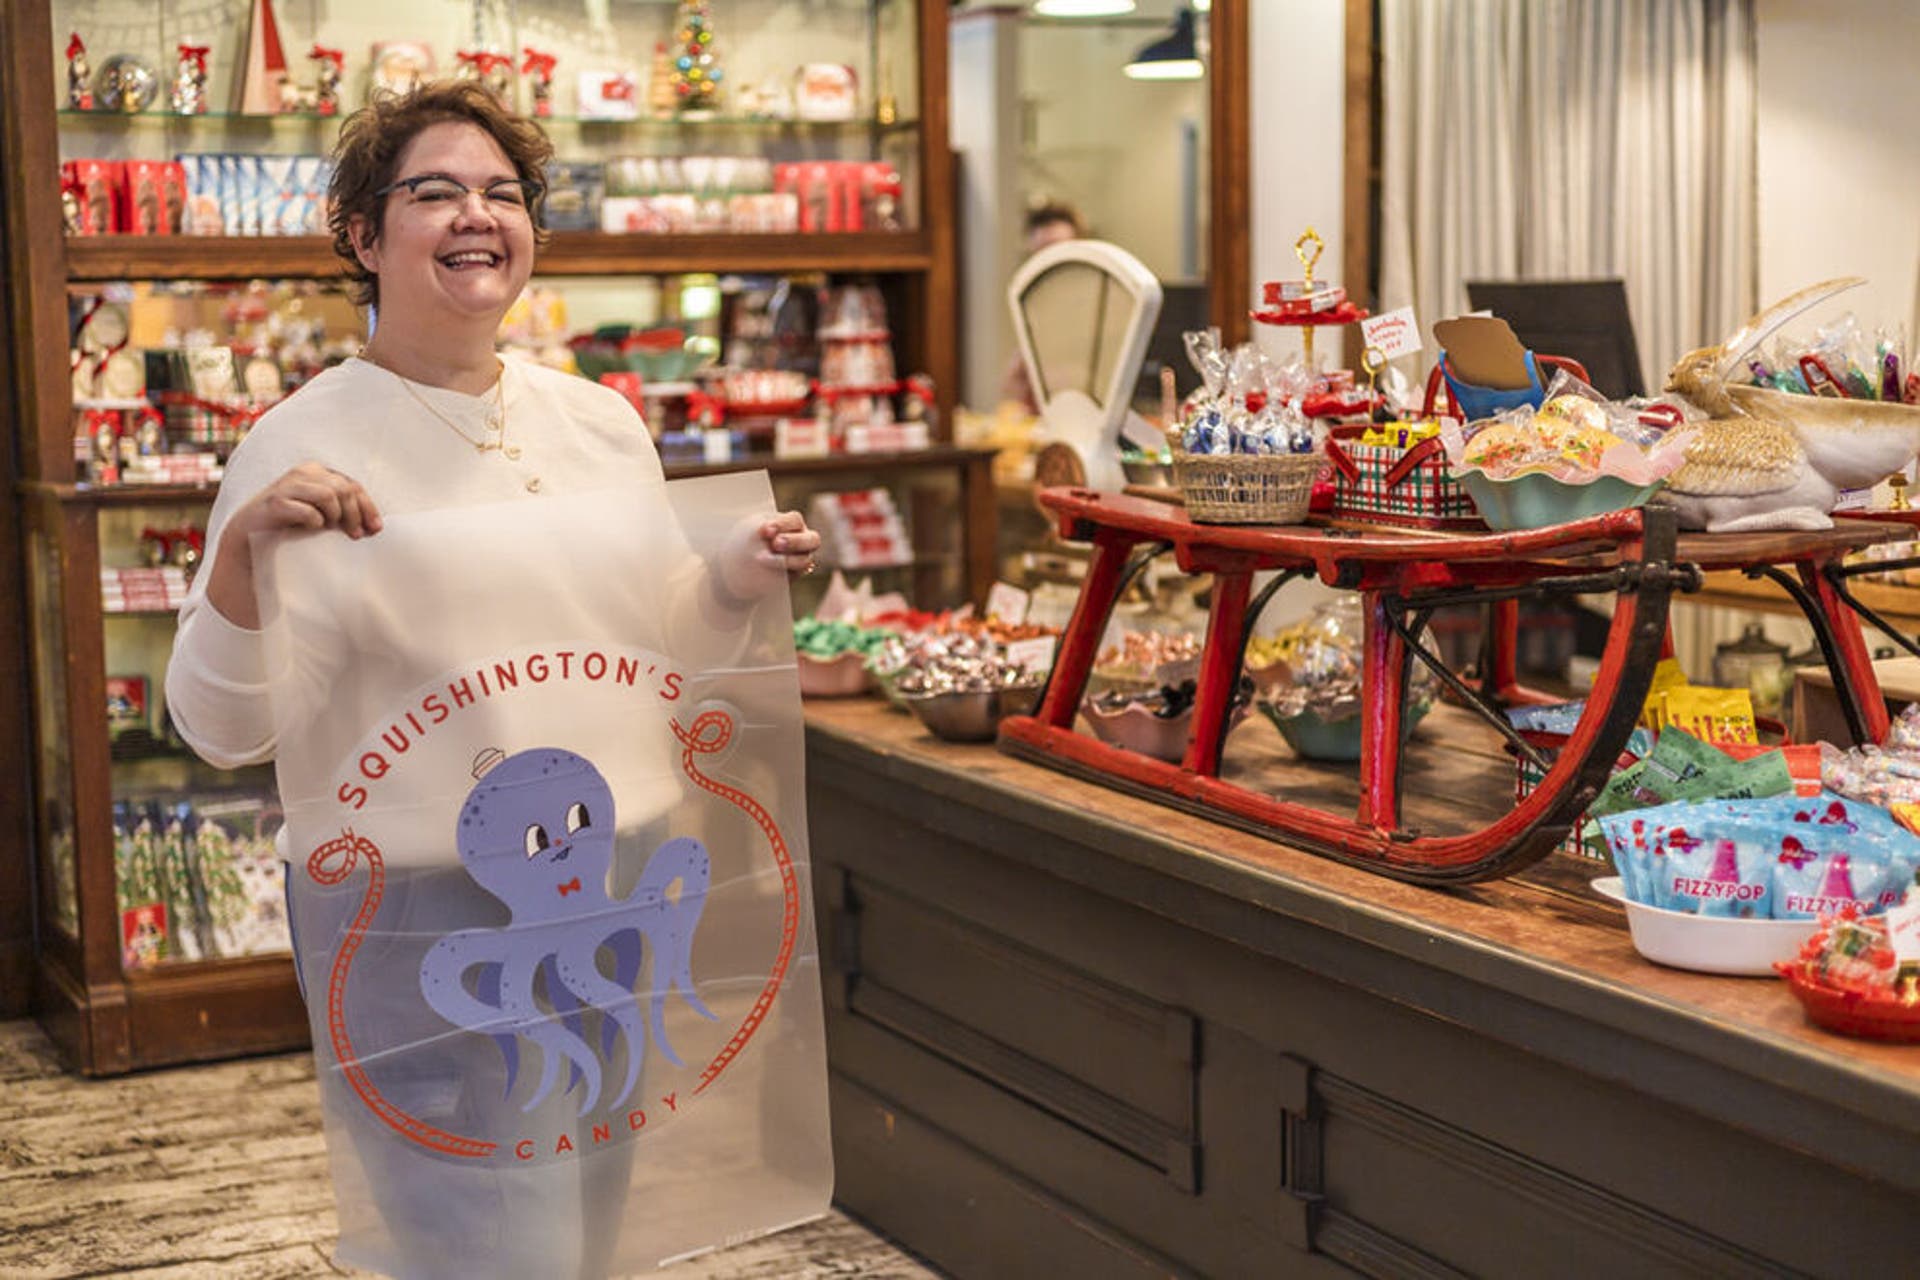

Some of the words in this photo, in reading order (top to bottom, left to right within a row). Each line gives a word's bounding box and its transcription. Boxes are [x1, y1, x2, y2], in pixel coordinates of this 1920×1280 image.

[337, 651, 684, 810] SQUISHINGTON'S
[1673, 877, 1765, 900] FIZZYPOP
[515, 1092, 679, 1160] CANDY
